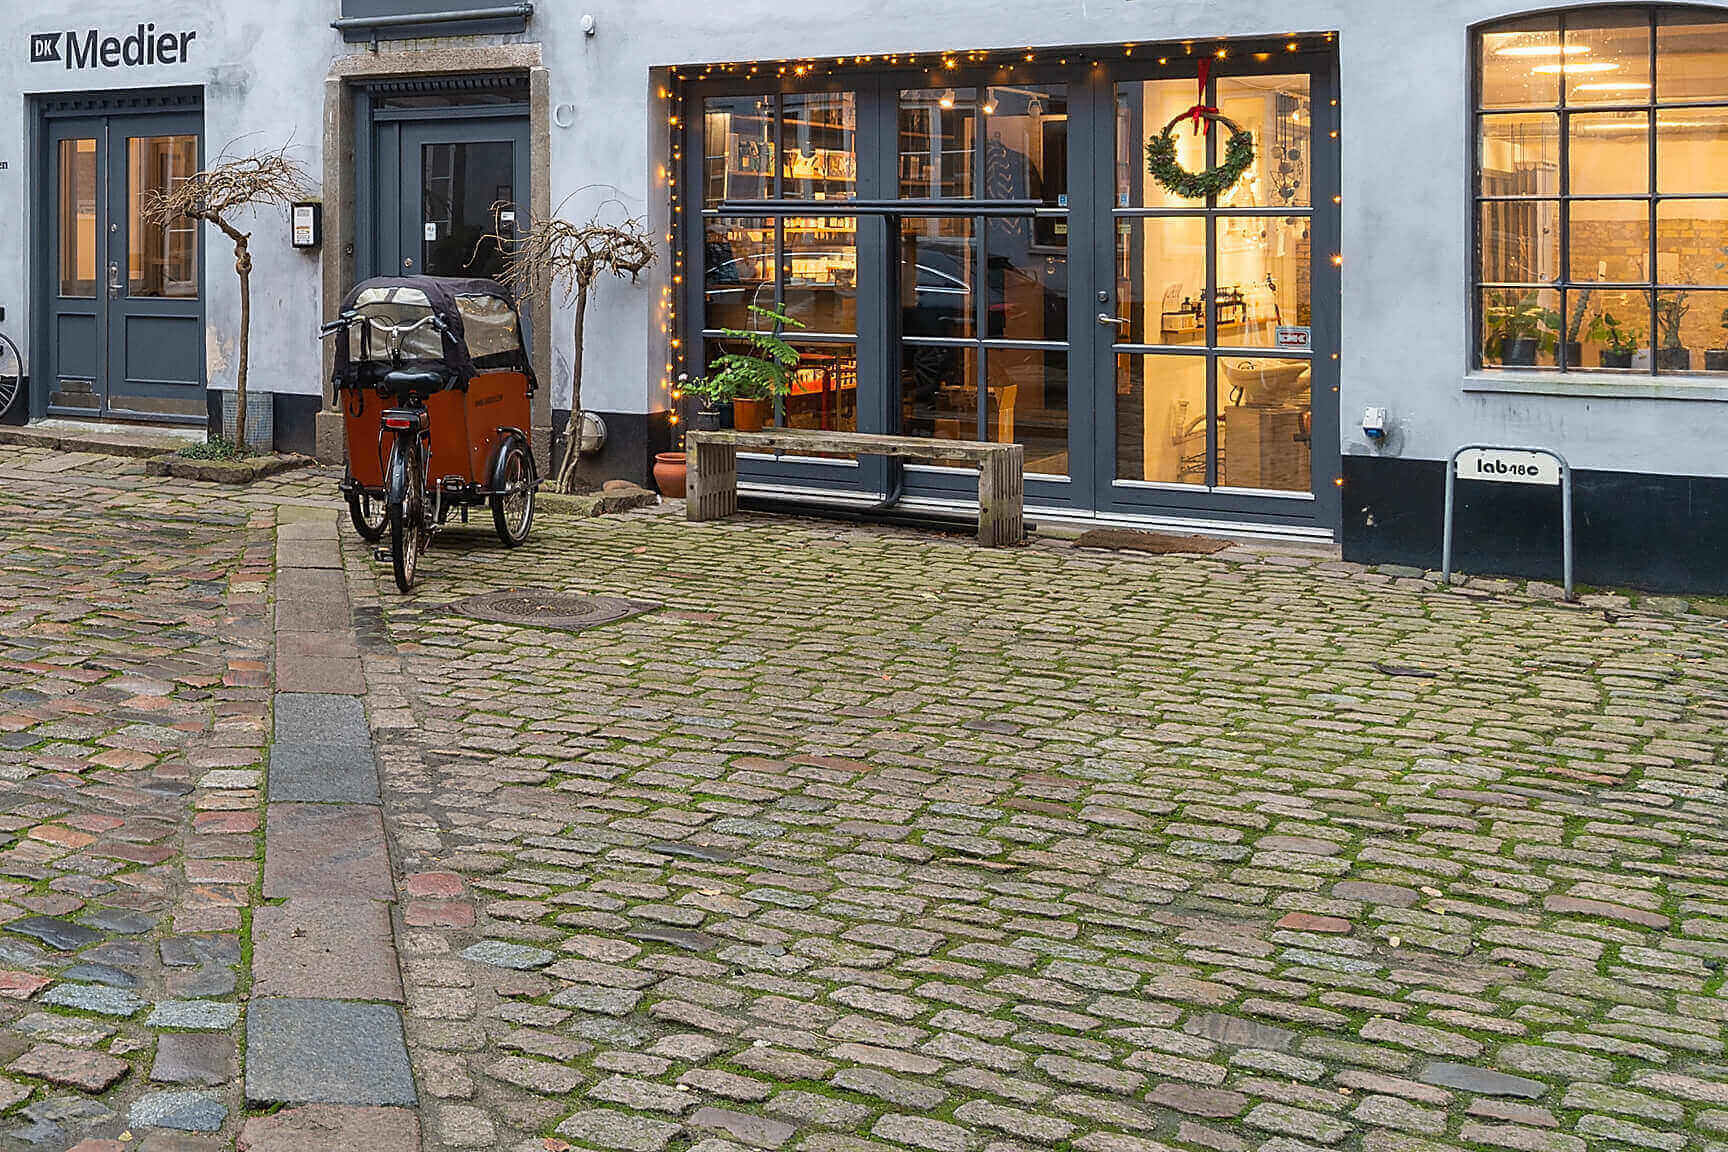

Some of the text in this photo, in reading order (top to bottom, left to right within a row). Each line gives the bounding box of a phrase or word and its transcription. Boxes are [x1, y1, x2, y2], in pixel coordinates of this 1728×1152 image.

[35, 22, 197, 70] DK Medier
[554, 104, 575, 129] C
